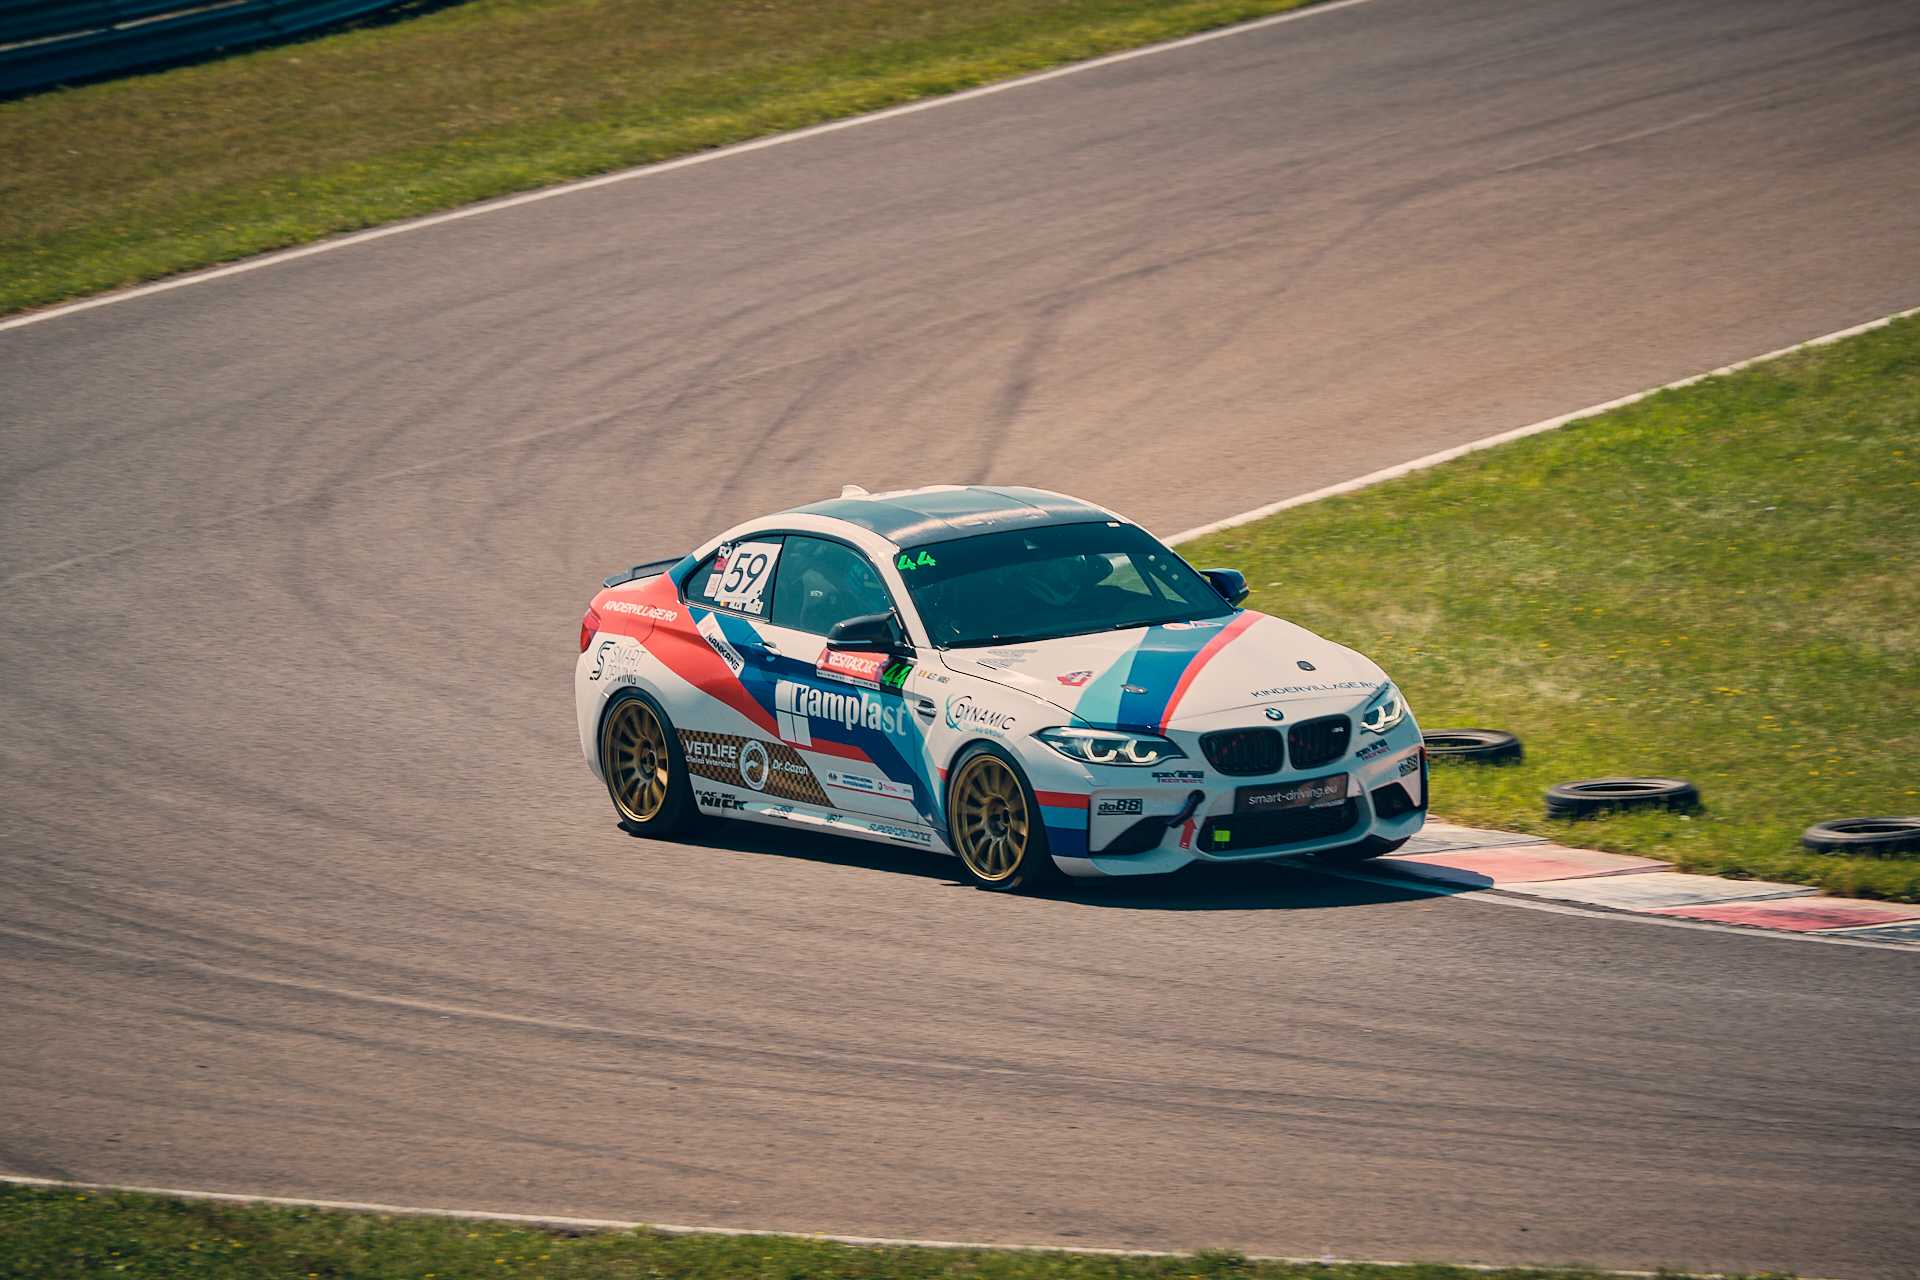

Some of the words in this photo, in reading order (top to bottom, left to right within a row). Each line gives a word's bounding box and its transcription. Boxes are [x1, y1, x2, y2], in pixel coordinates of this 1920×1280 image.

[897, 551, 937, 571] 44
[724, 553, 768, 593] 59
[883, 663, 913, 689] 44
[955, 703, 1016, 730] DYNAMIC
[685, 740, 737, 760] VETLIFE
[772, 759, 783, 771] Dr.
[784, 761, 808, 774] Cazan
[700, 796, 749, 811] NICK
